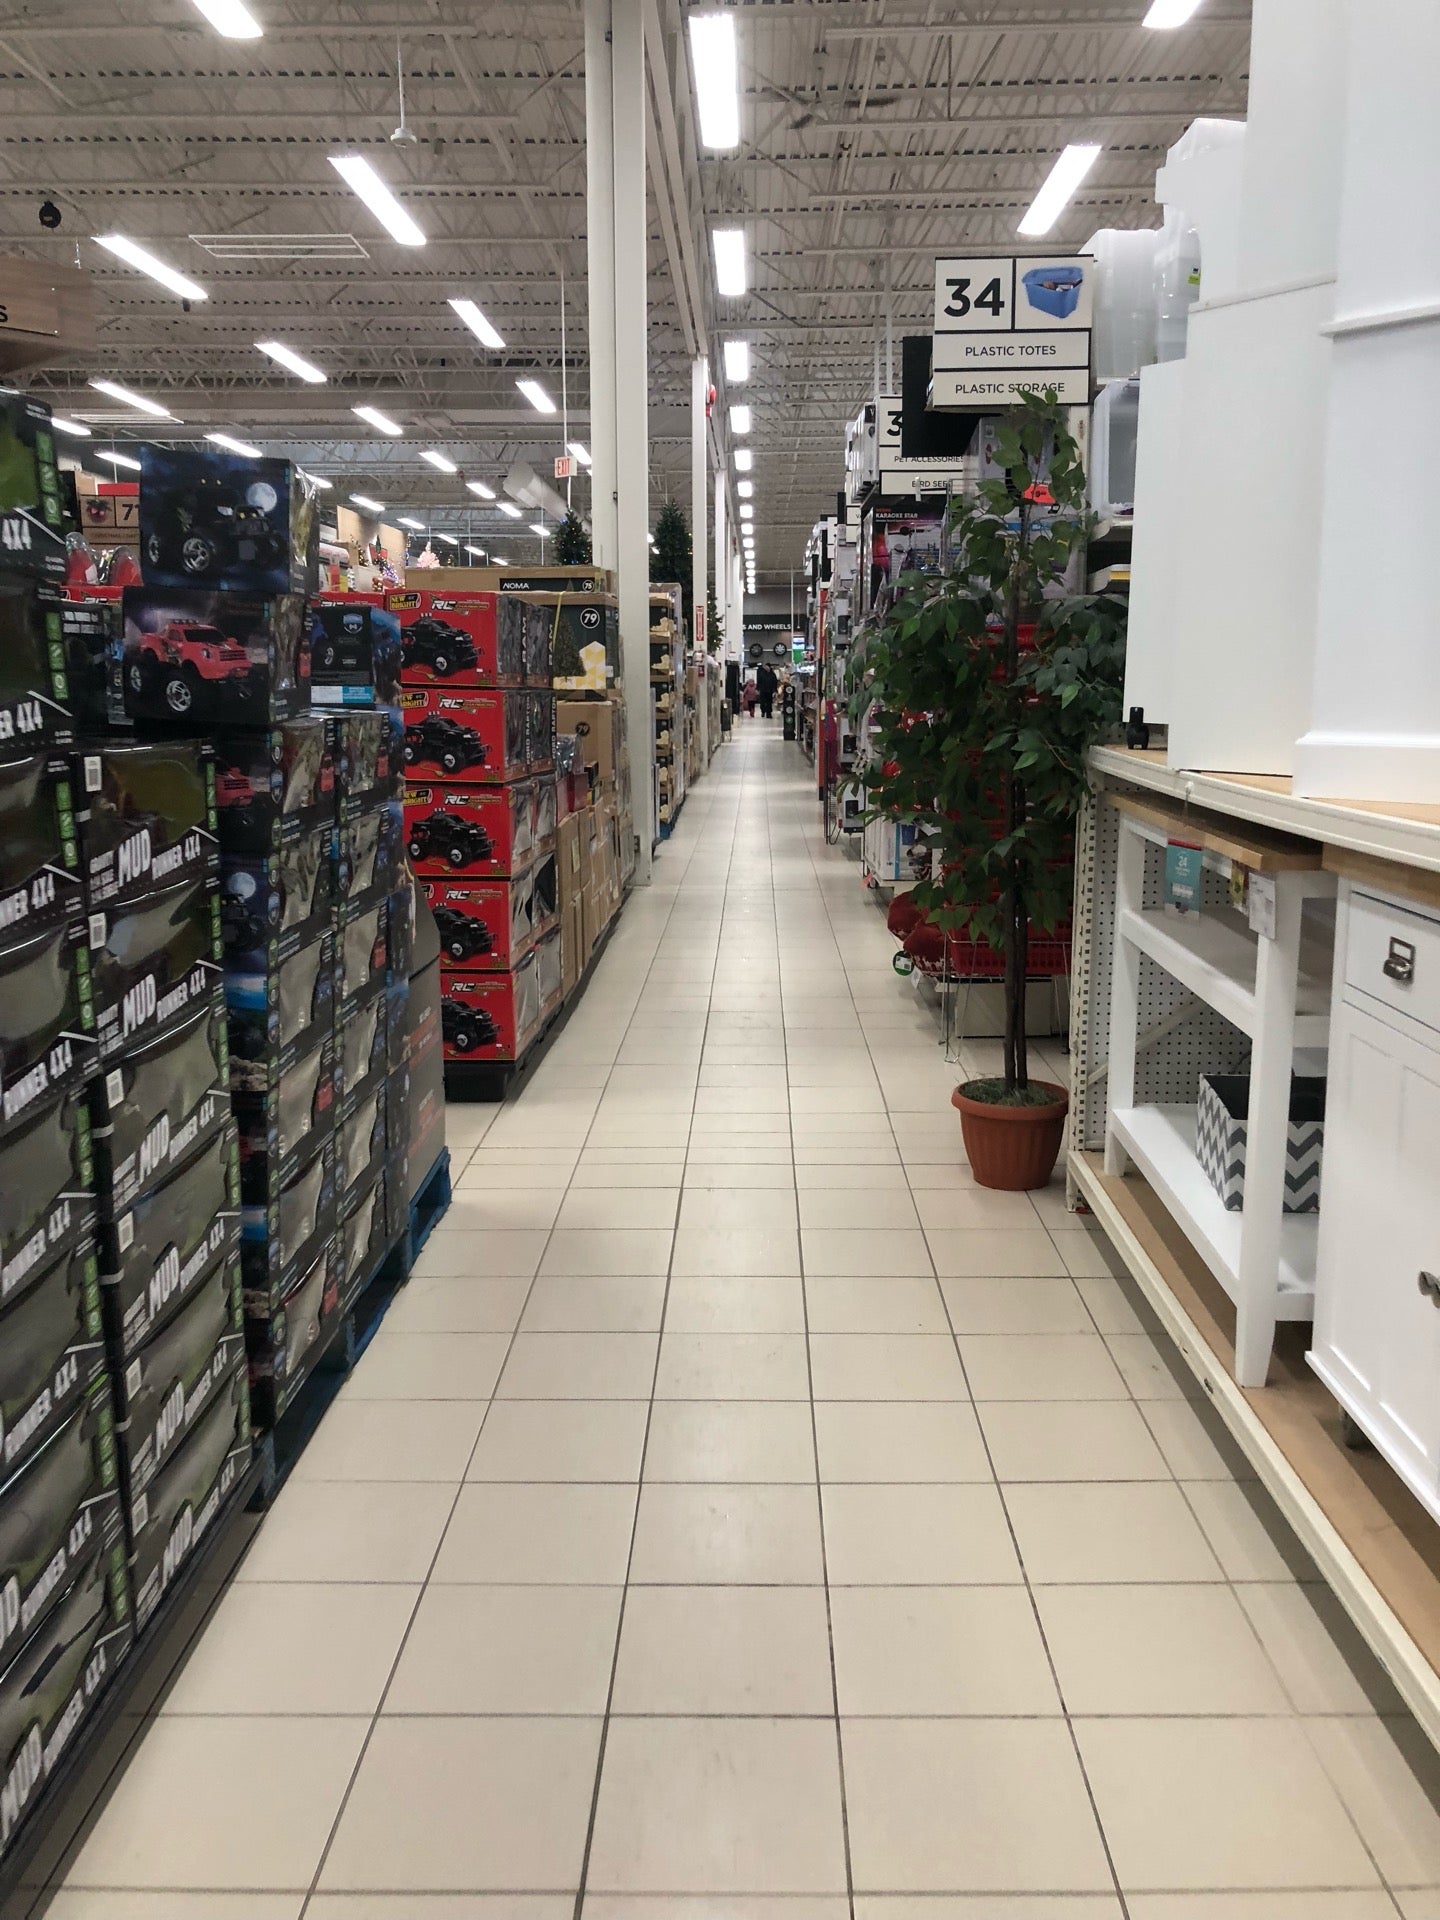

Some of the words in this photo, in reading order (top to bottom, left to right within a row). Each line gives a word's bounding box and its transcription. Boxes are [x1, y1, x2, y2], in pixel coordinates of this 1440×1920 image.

[944, 278, 1005, 317] 34
[965, 346, 1015, 357] PLASTIC
[1018, 345, 1057, 356] TOTES
[955, 383, 1005, 394] PLASTIC
[1008, 382, 1065, 394] STORAGE
[894, 455, 909, 463] PET
[502, 582, 530, 590] NOMA
[583, 613, 598, 624] 79
[118, 829, 151, 888] MUD
[123, 973, 157, 1038] MUD
[140, 1113, 169, 1185] MUD
[149, 1246, 180, 1322] MUD
[156, 1381, 185, 1461] MUD
